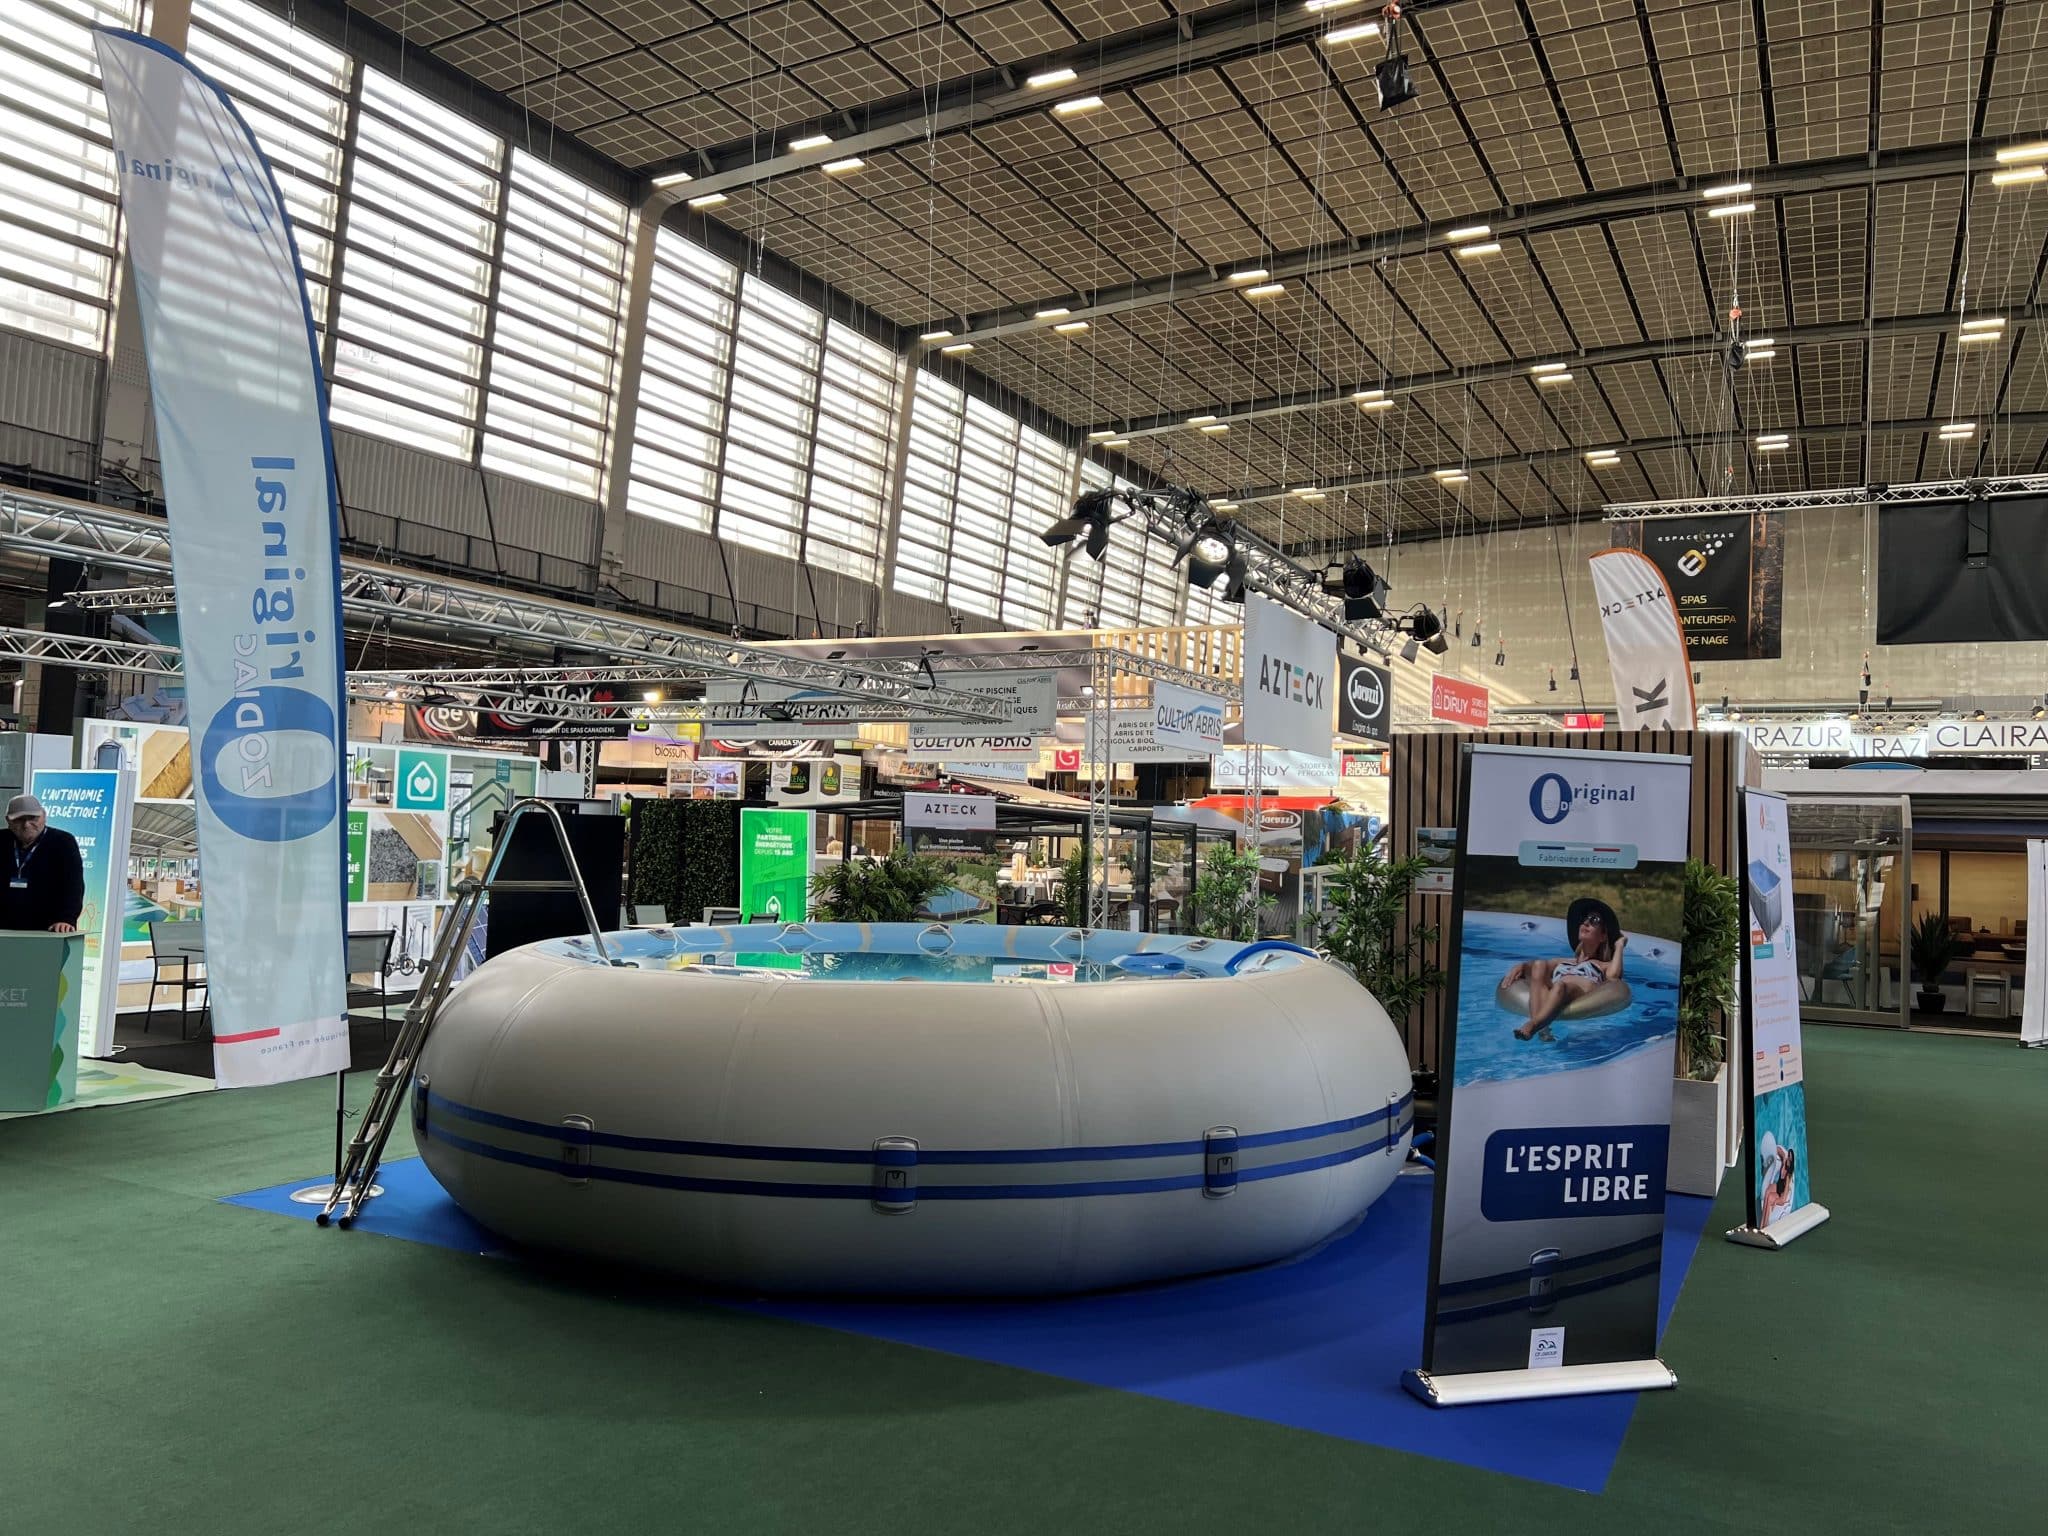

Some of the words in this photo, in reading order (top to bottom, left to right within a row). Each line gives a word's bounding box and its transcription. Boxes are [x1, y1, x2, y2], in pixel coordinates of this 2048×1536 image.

[1657, 534, 1698, 542] ESPACE
[1705, 532, 1734, 540] SPAS
[1680, 594, 1708, 606] SPAS
[1686, 636, 1700, 645] DE
[1701, 635, 1729, 645] NAGE
[1260, 654, 1324, 710] AZTECK
[986, 686, 1018, 694] PISCINE
[1352, 678, 1380, 706] Jacuzzi
[654, 743, 687, 760] biossun
[41, 788, 105, 803] L'AUTONOMIE
[924, 803, 977, 815] AZTECK
[1591, 855, 1617, 864] France
[1505, 1142, 1634, 1173] L'ESPRIT
[1563, 1174, 1649, 1203] LIBRE
